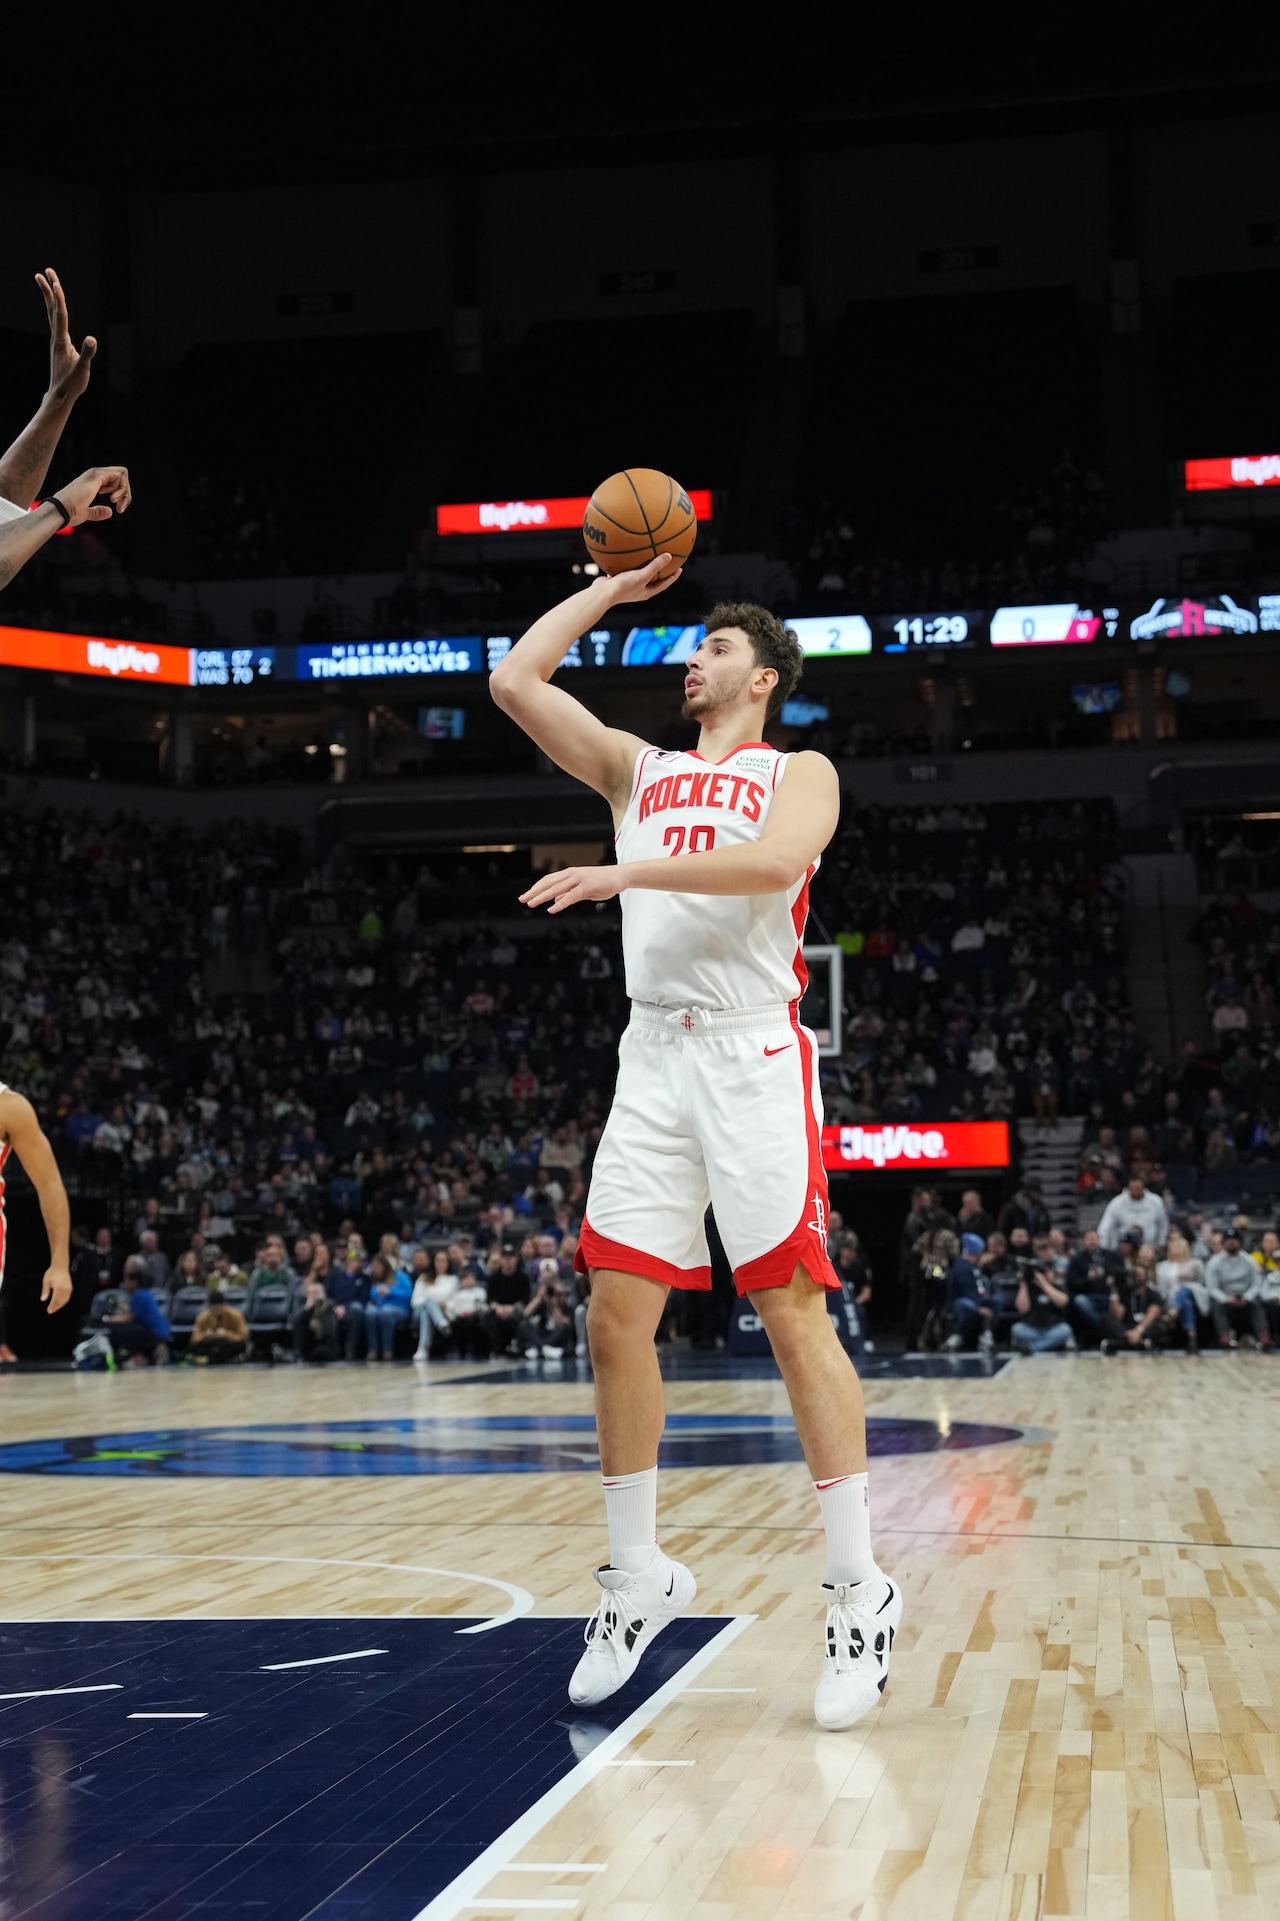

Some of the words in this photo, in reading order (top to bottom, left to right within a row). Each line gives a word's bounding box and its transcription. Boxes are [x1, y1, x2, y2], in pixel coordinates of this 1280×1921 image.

[827, 628, 843, 649] 2
[893, 615, 968, 644] 11:29
[1022, 618, 1036, 640] 0
[258, 657, 273, 675] 2
[308, 650, 471, 678] TIMBERWOLVES
[736, 760, 771, 770] karma
[740, 756, 771, 764] credit
[639, 772, 765, 824] ROCKETS
